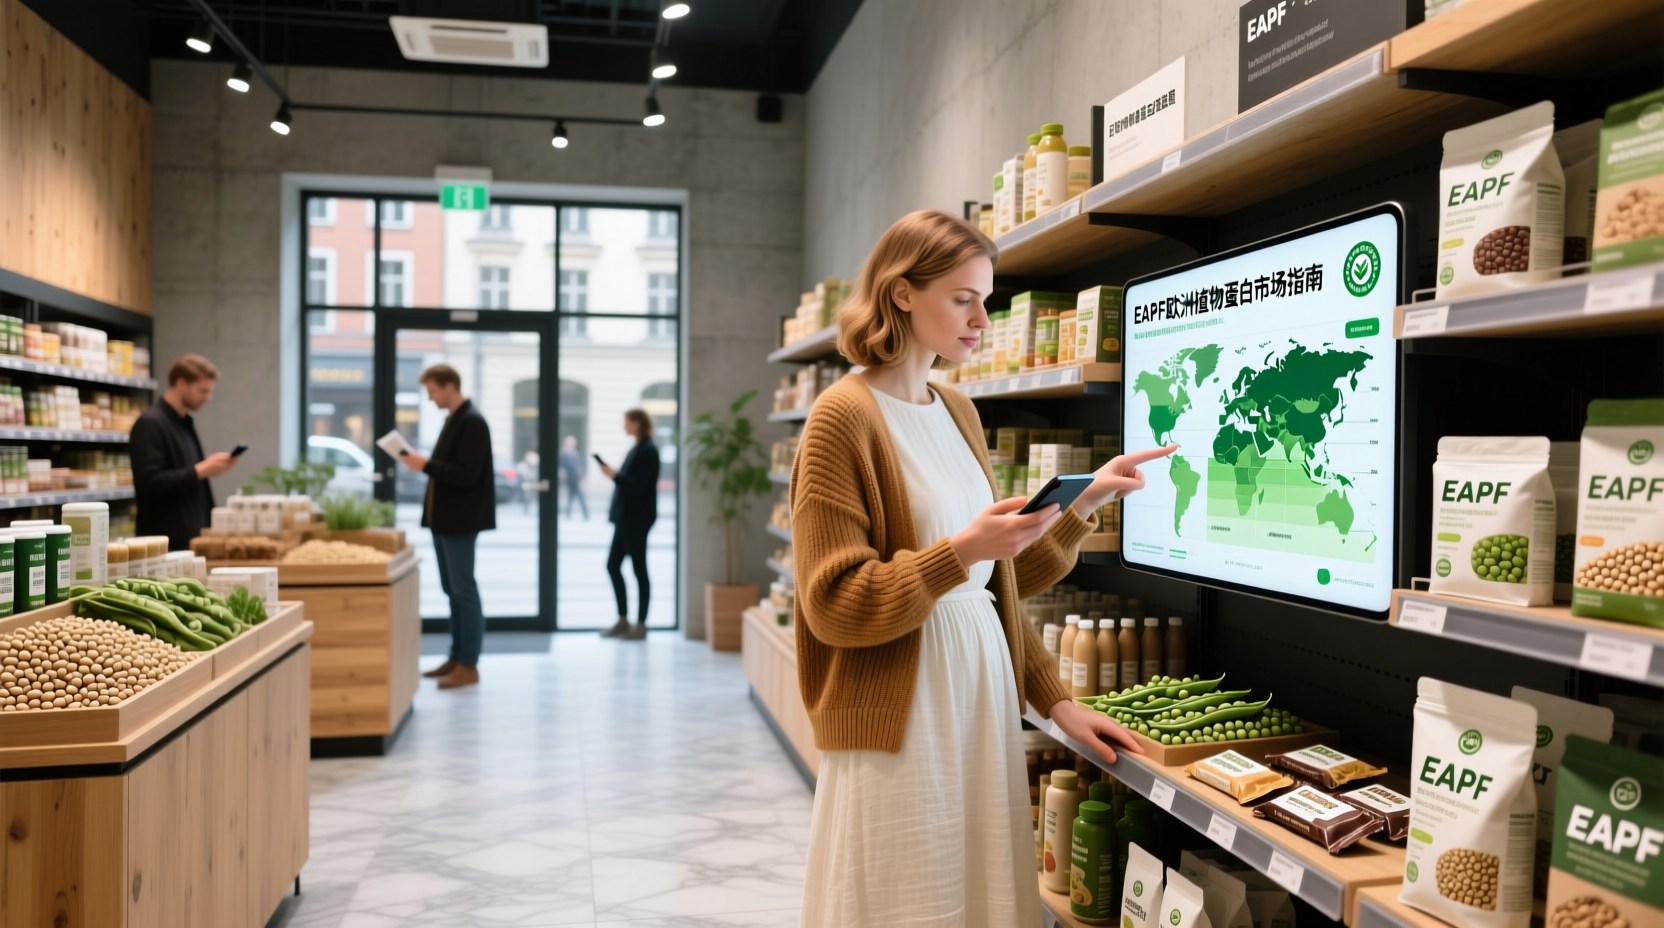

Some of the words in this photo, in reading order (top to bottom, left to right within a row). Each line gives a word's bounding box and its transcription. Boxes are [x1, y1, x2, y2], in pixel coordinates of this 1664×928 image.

[1247, 1, 1287, 43] EAPF
[1447, 172, 1515, 207] EAPF
[1441, 480, 1512, 504] EAPF
[1587, 475, 1664, 502] EAPF
[1419, 755, 1494, 800] EAPF
[1566, 804, 1664, 864] EAPF
